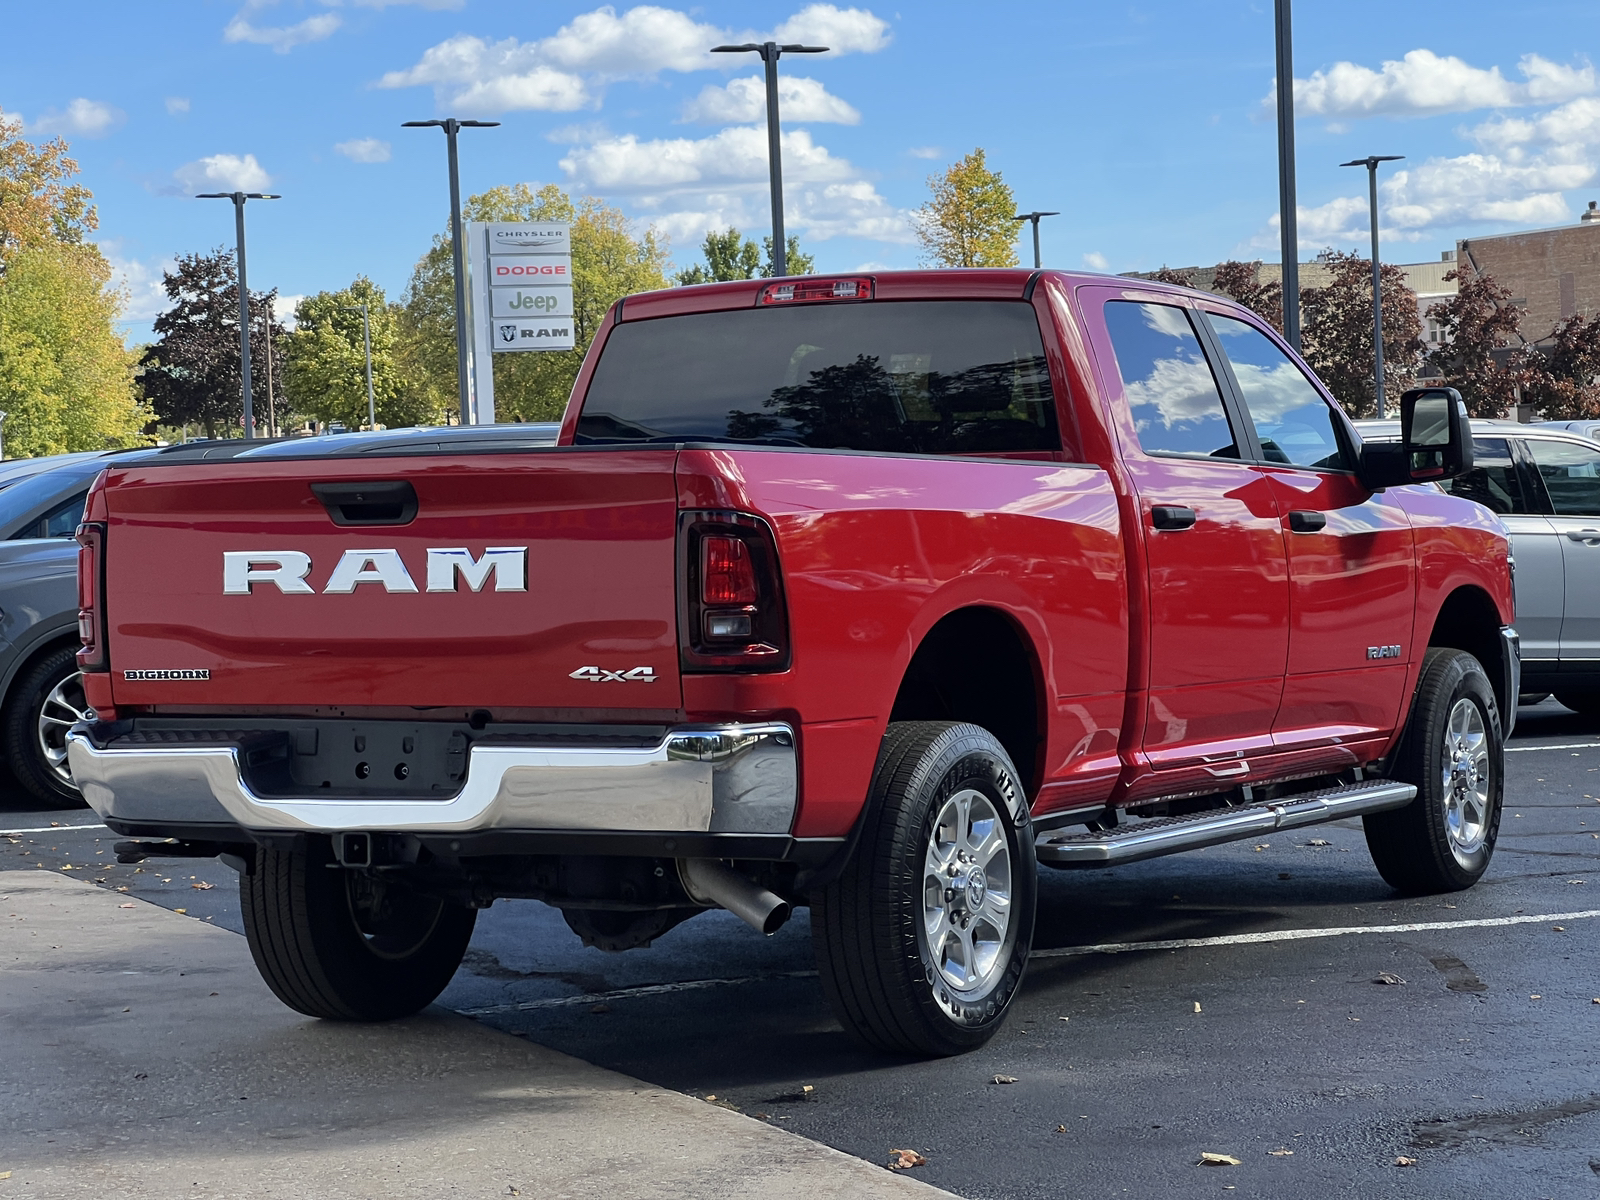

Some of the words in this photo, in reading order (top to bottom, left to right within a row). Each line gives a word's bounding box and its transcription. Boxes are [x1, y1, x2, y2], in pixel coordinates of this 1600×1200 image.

[496, 266, 566, 275] DODGE
[509, 291, 558, 312] Jeep
[520, 328, 569, 338] RAM
[222, 546, 529, 595] RAM
[1366, 645, 1402, 659] RAM
[123, 669, 210, 681] BIGHORN
[568, 665, 659, 682] 4x4
